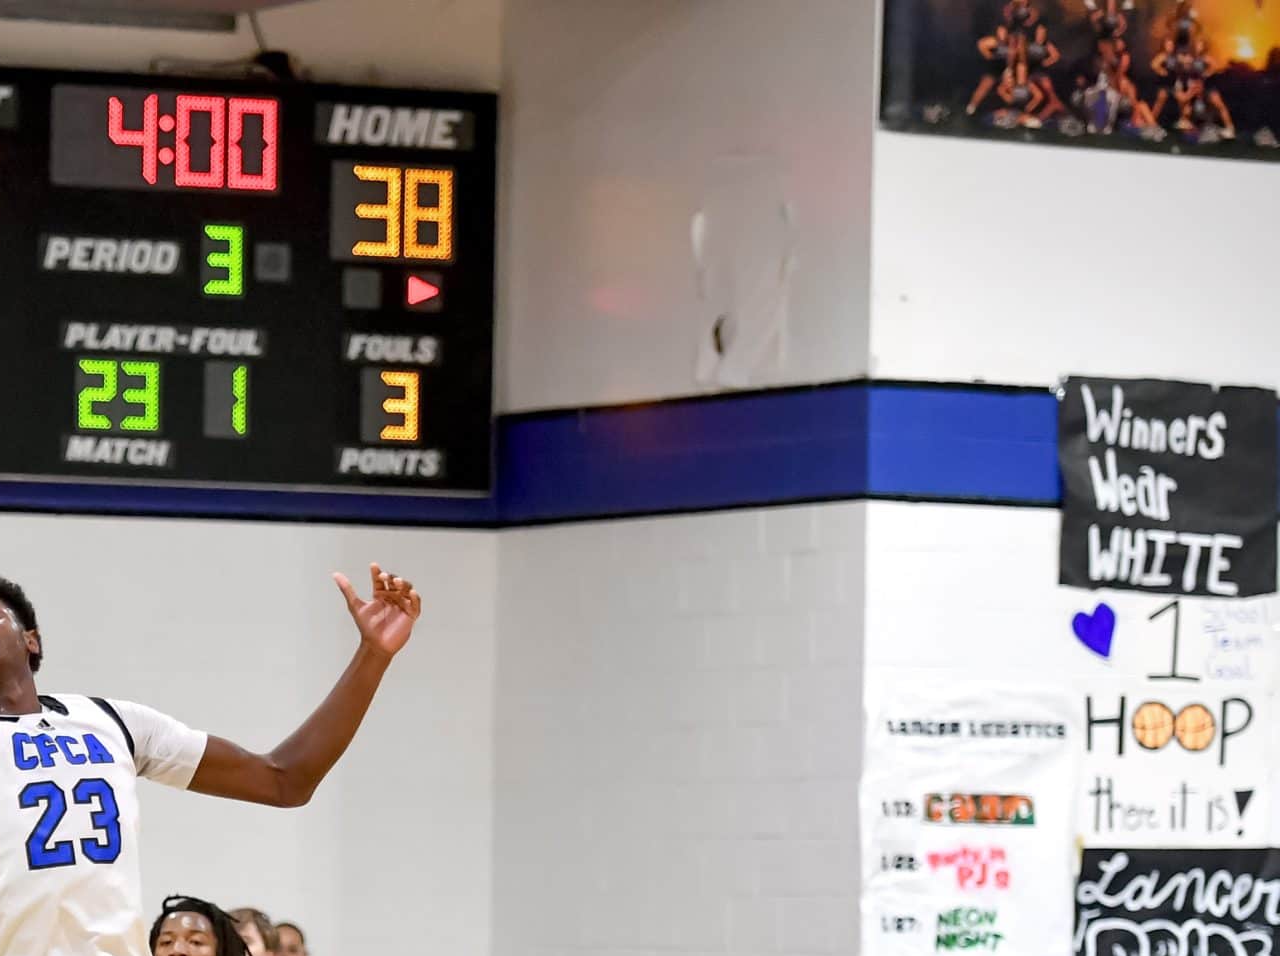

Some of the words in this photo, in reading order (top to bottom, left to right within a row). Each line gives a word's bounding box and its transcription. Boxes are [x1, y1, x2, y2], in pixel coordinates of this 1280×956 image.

[108, 94, 278, 191] 4:00
[327, 103, 464, 149] HOME
[352, 165, 454, 260] 38
[43, 236, 181, 274] PERIOD
[204, 224, 244, 295] 3
[346, 334, 438, 364] FOULS
[78, 359, 160, 431] 23
[231, 365, 248, 435] 1
[380, 371, 420, 441] 3
[1080, 383, 1228, 459] Winners
[65, 435, 171, 467] MATCH
[338, 447, 441, 477] POINTS
[1087, 448, 1178, 521] Wear
[1087, 523, 1244, 596] WHITE
[11, 731, 115, 771] CFCA
[17, 777, 122, 871] 23
[1170, 781, 1199, 831] it
[936, 907, 998, 930] NEON
[1076, 851, 1280, 926] Lancer
[934, 932, 1006, 953] NIGHT
